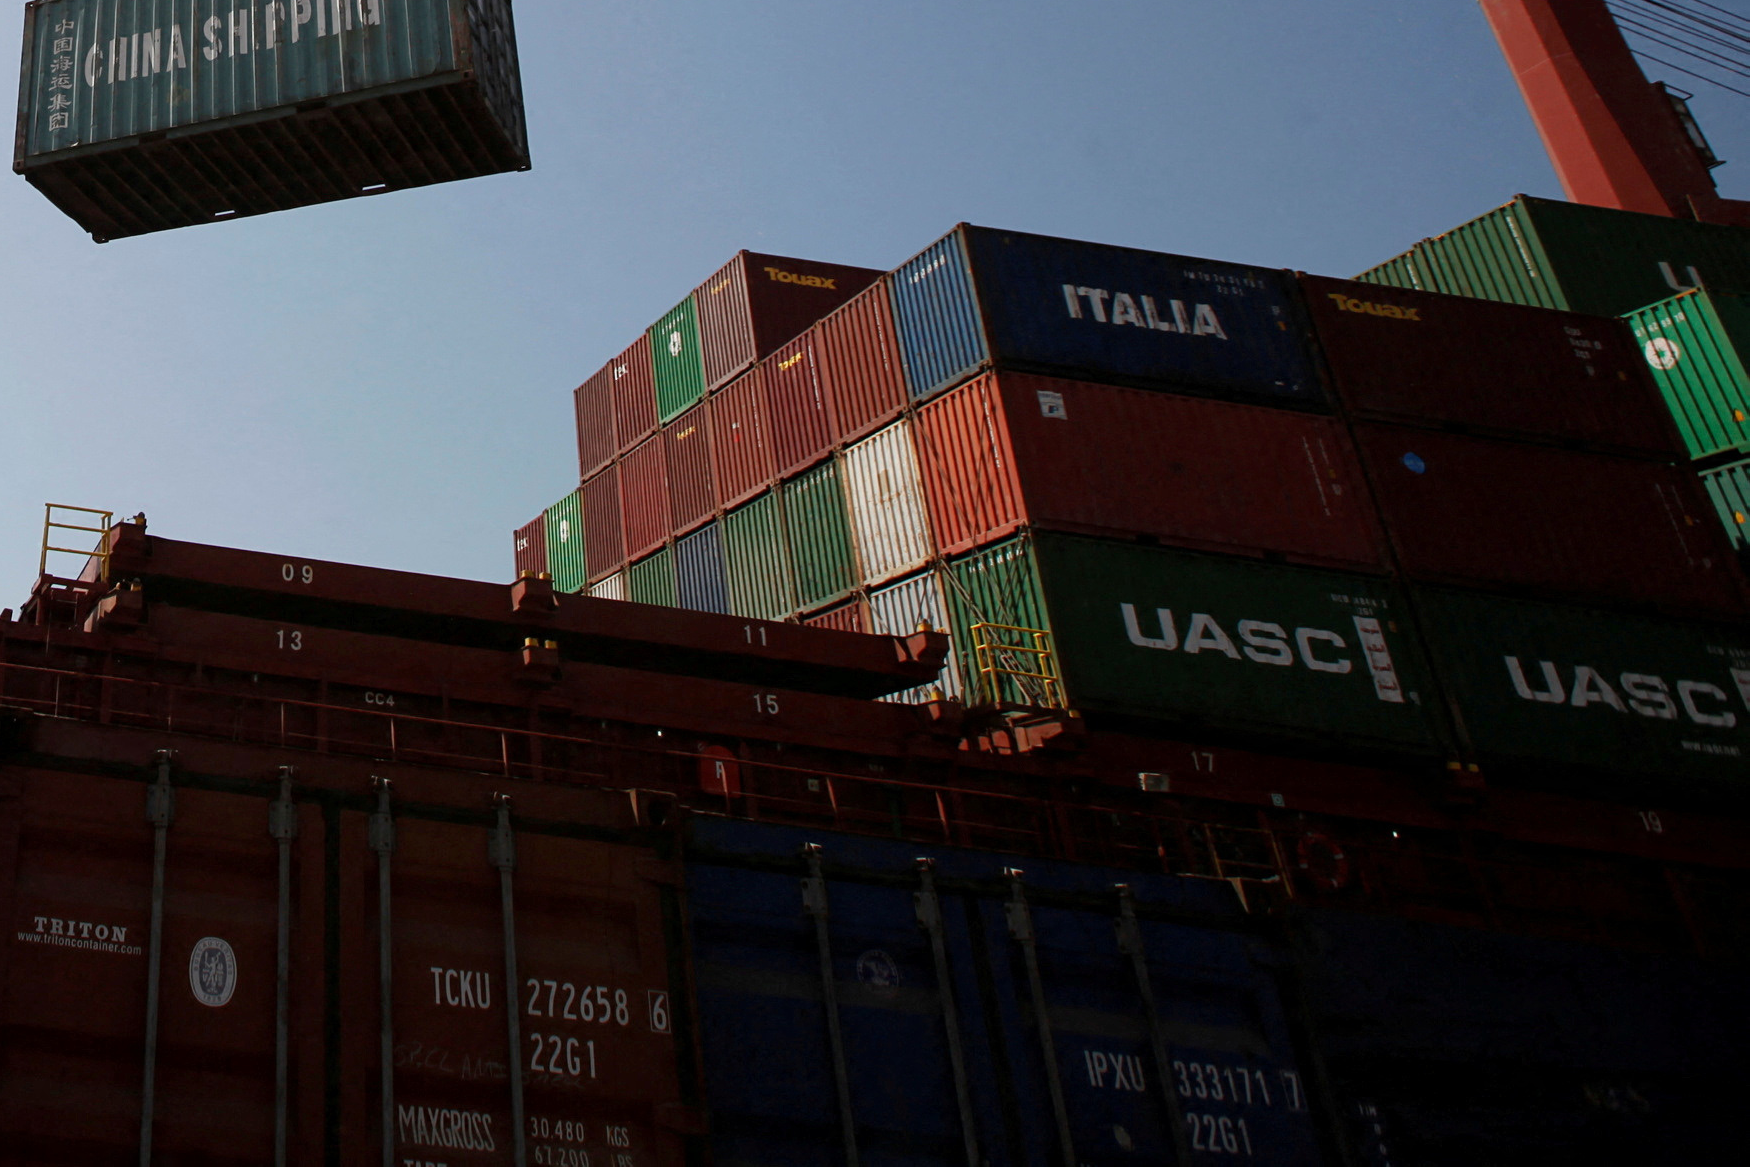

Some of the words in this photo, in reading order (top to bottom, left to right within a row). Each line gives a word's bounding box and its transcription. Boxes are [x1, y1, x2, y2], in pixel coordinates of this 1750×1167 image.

[84, 23, 187, 88] CHINA
[1062, 283, 1229, 341] ITALIA
[281, 563, 314, 584] 09
[276, 629, 302, 651] 13
[743, 624, 767, 647] 11
[1119, 601, 1353, 674] UASC
[364, 691, 395, 706] CC4
[753, 693, 780, 715] 15
[1503, 655, 1738, 729] UASC
[1191, 750, 1214, 773] 17
[1639, 810, 1663, 834] 19
[17, 931, 142, 956] www.tritoncontainer.com
[34, 915, 128, 943] TRITON
[430, 966, 491, 1009] TCKU
[527, 978, 630, 1026] 272658
[652, 994, 667, 1030] 6
[530, 1033, 596, 1079] 22G1
[1084, 1049, 1146, 1093] IPXU
[1173, 1059, 1271, 1107] 333171
[530, 1116, 585, 1143] 30.480
[605, 1125, 630, 1148] KGS
[1187, 1111, 1252, 1157] 22G1
